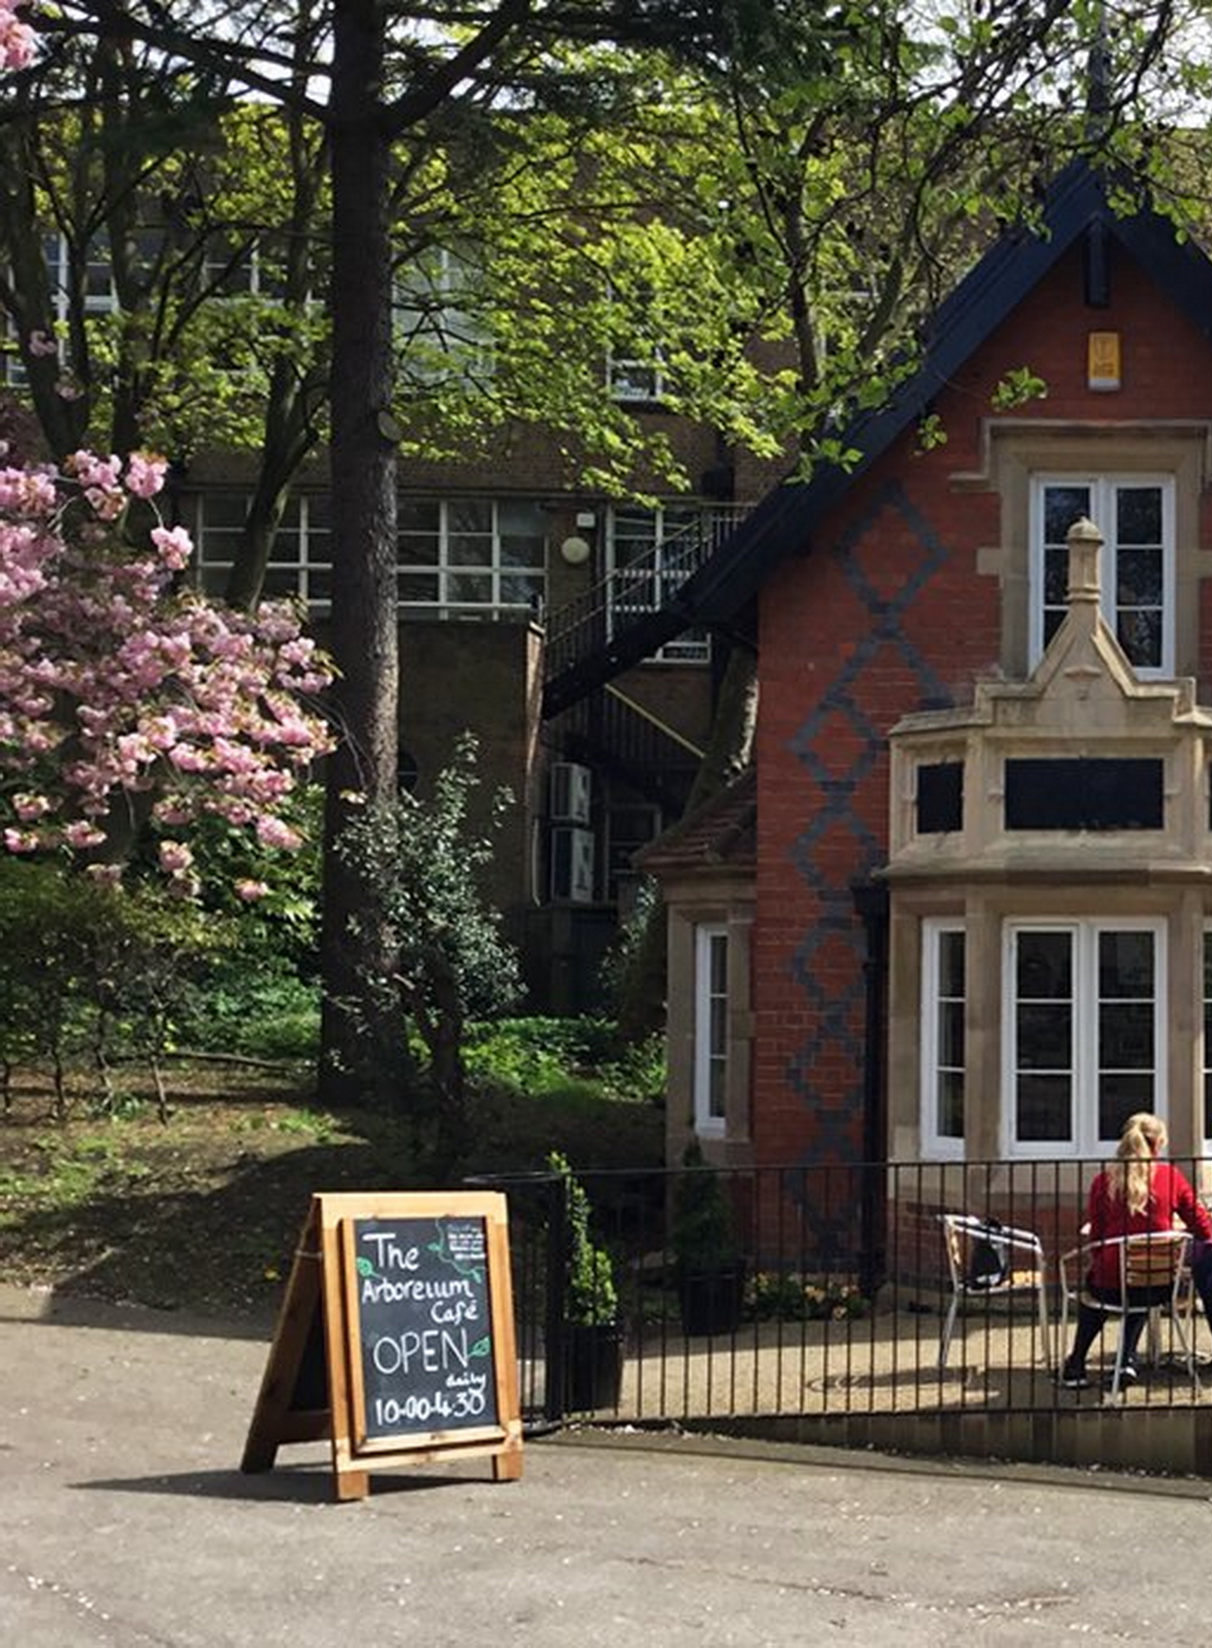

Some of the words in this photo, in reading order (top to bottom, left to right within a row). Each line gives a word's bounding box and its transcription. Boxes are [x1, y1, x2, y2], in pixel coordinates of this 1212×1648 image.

[361, 1232, 421, 1271] The
[361, 1278, 475, 1304] Arboretum
[430, 1300, 480, 1326] Café
[372, 1327, 469, 1375] OPEN
[445, 1372, 487, 1393] daily
